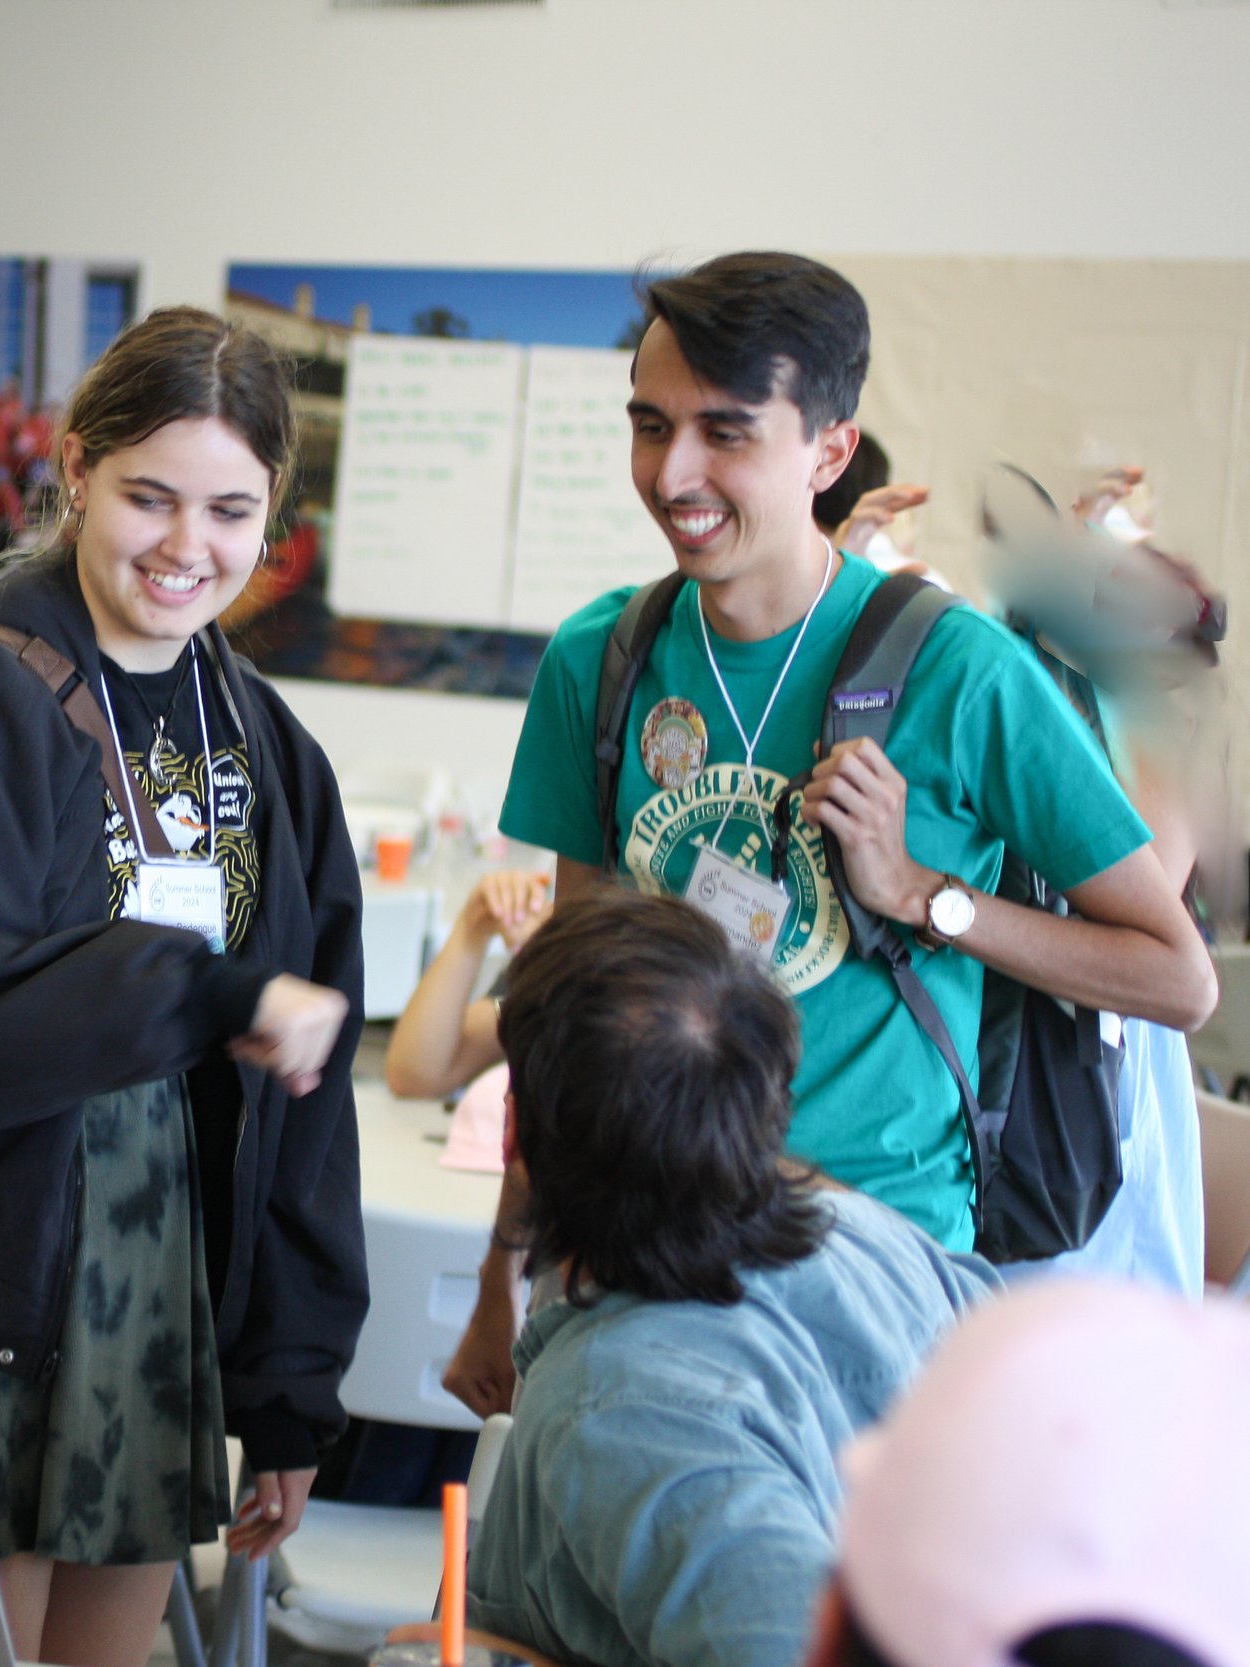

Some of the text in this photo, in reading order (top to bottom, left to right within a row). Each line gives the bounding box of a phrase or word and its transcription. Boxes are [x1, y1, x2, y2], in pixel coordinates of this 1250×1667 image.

[839, 698, 884, 711] patagonia
[630, 767, 829, 877] TROUBLEMKERS
[667, 815, 690, 841] AND
[165, 883, 217, 894] Summer School
[182, 896, 200, 909] 2024
[720, 881, 777, 918] Summer School
